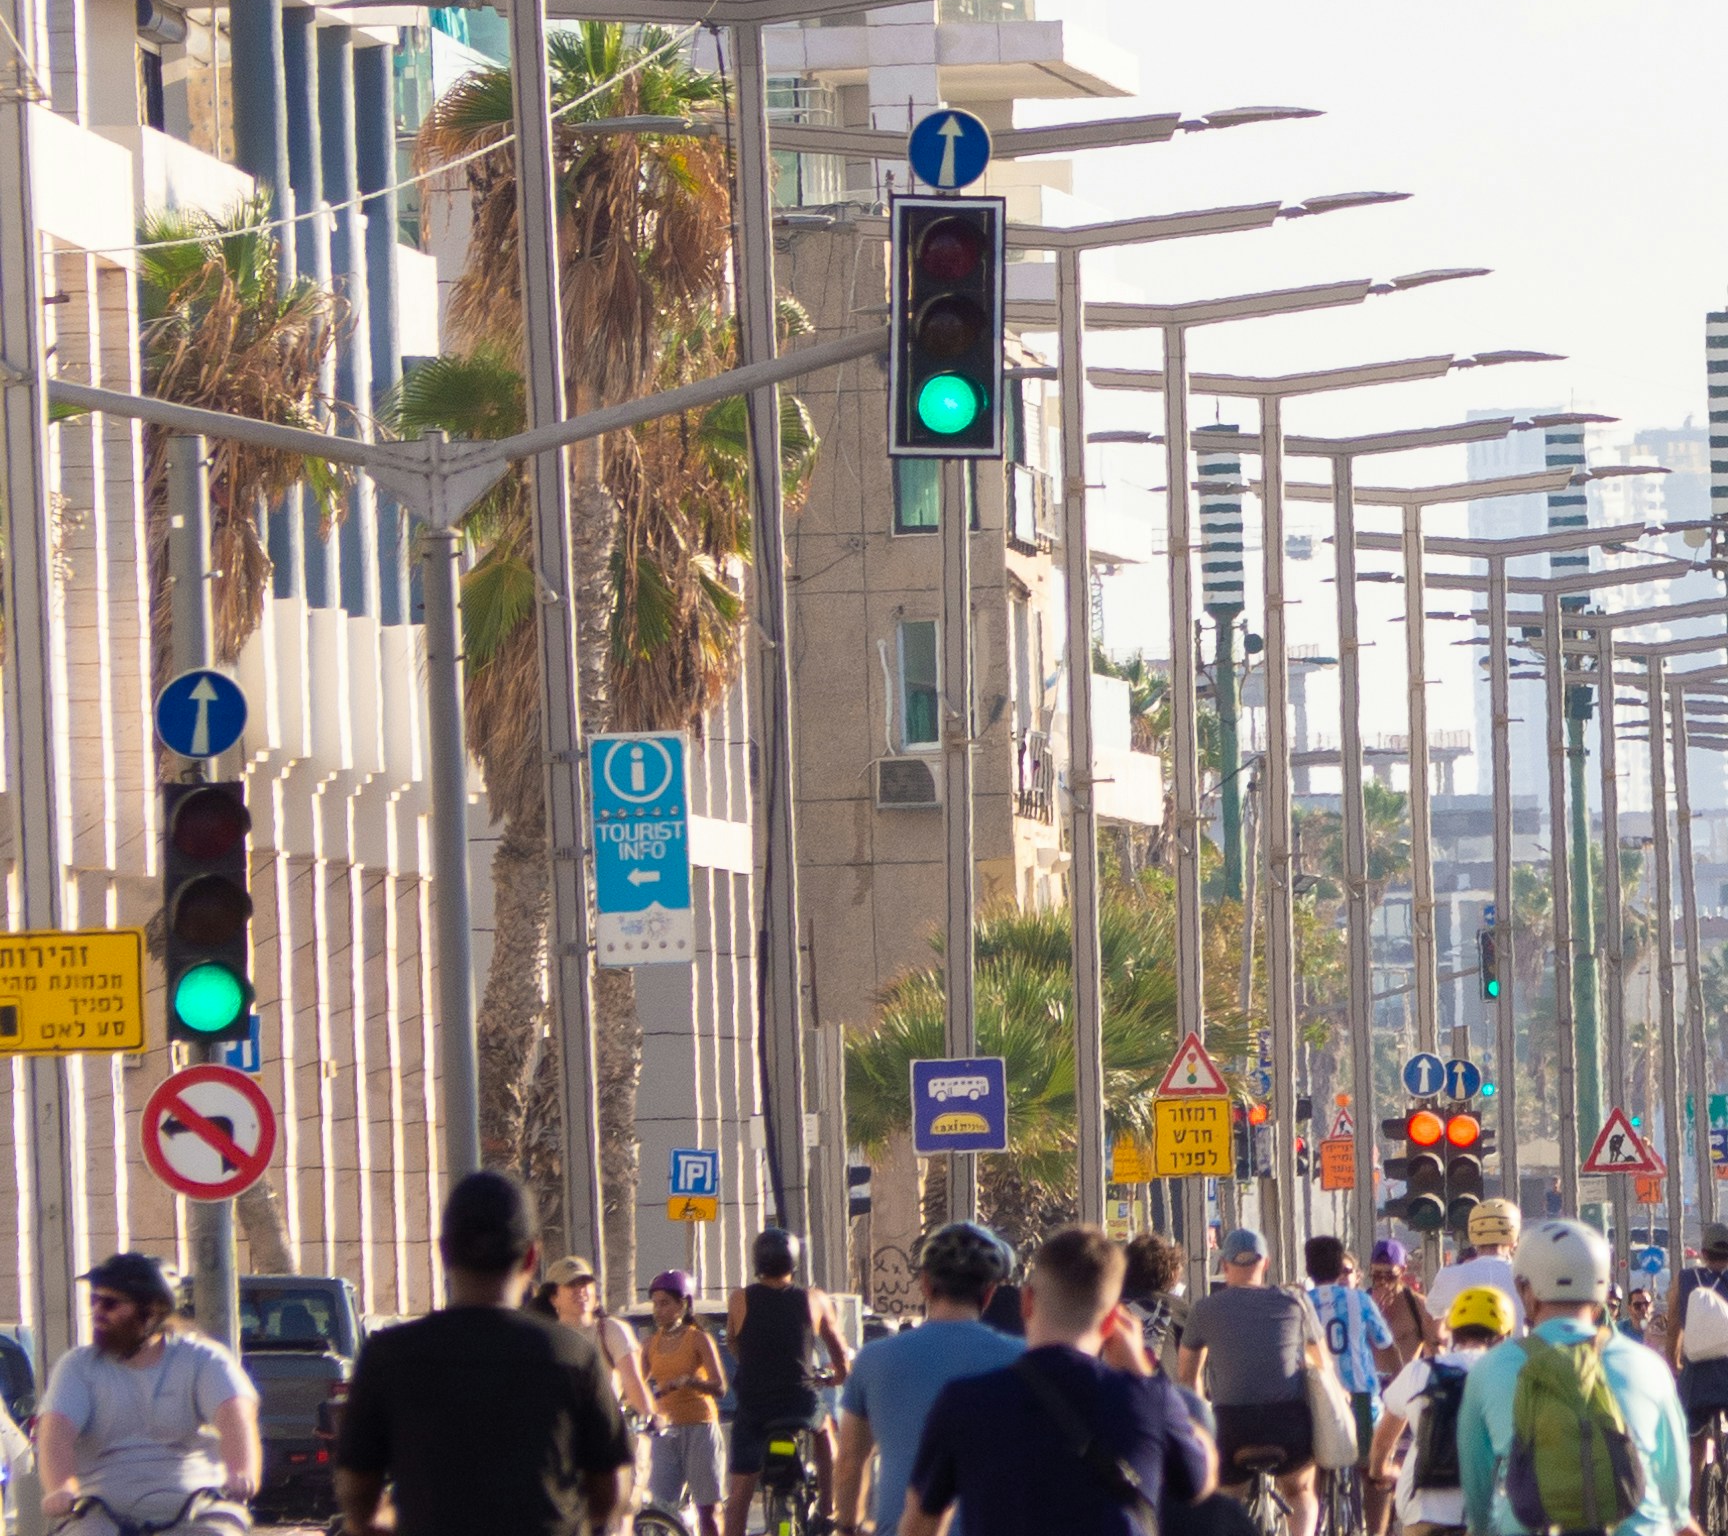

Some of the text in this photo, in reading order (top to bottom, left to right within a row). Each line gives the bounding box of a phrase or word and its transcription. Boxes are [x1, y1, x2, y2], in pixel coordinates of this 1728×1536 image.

[597, 820, 684, 843] TOURIST
[618, 841, 667, 861] INFO
[0, 946, 88, 968] זהירות
[0, 976, 36, 992] מהי
[68, 996, 124, 1016] לפניך
[1169, 1106, 1217, 1122] רמזור
[1173, 1129, 1212, 1144] חדש
[1170, 1149, 1218, 1168] לפניך
